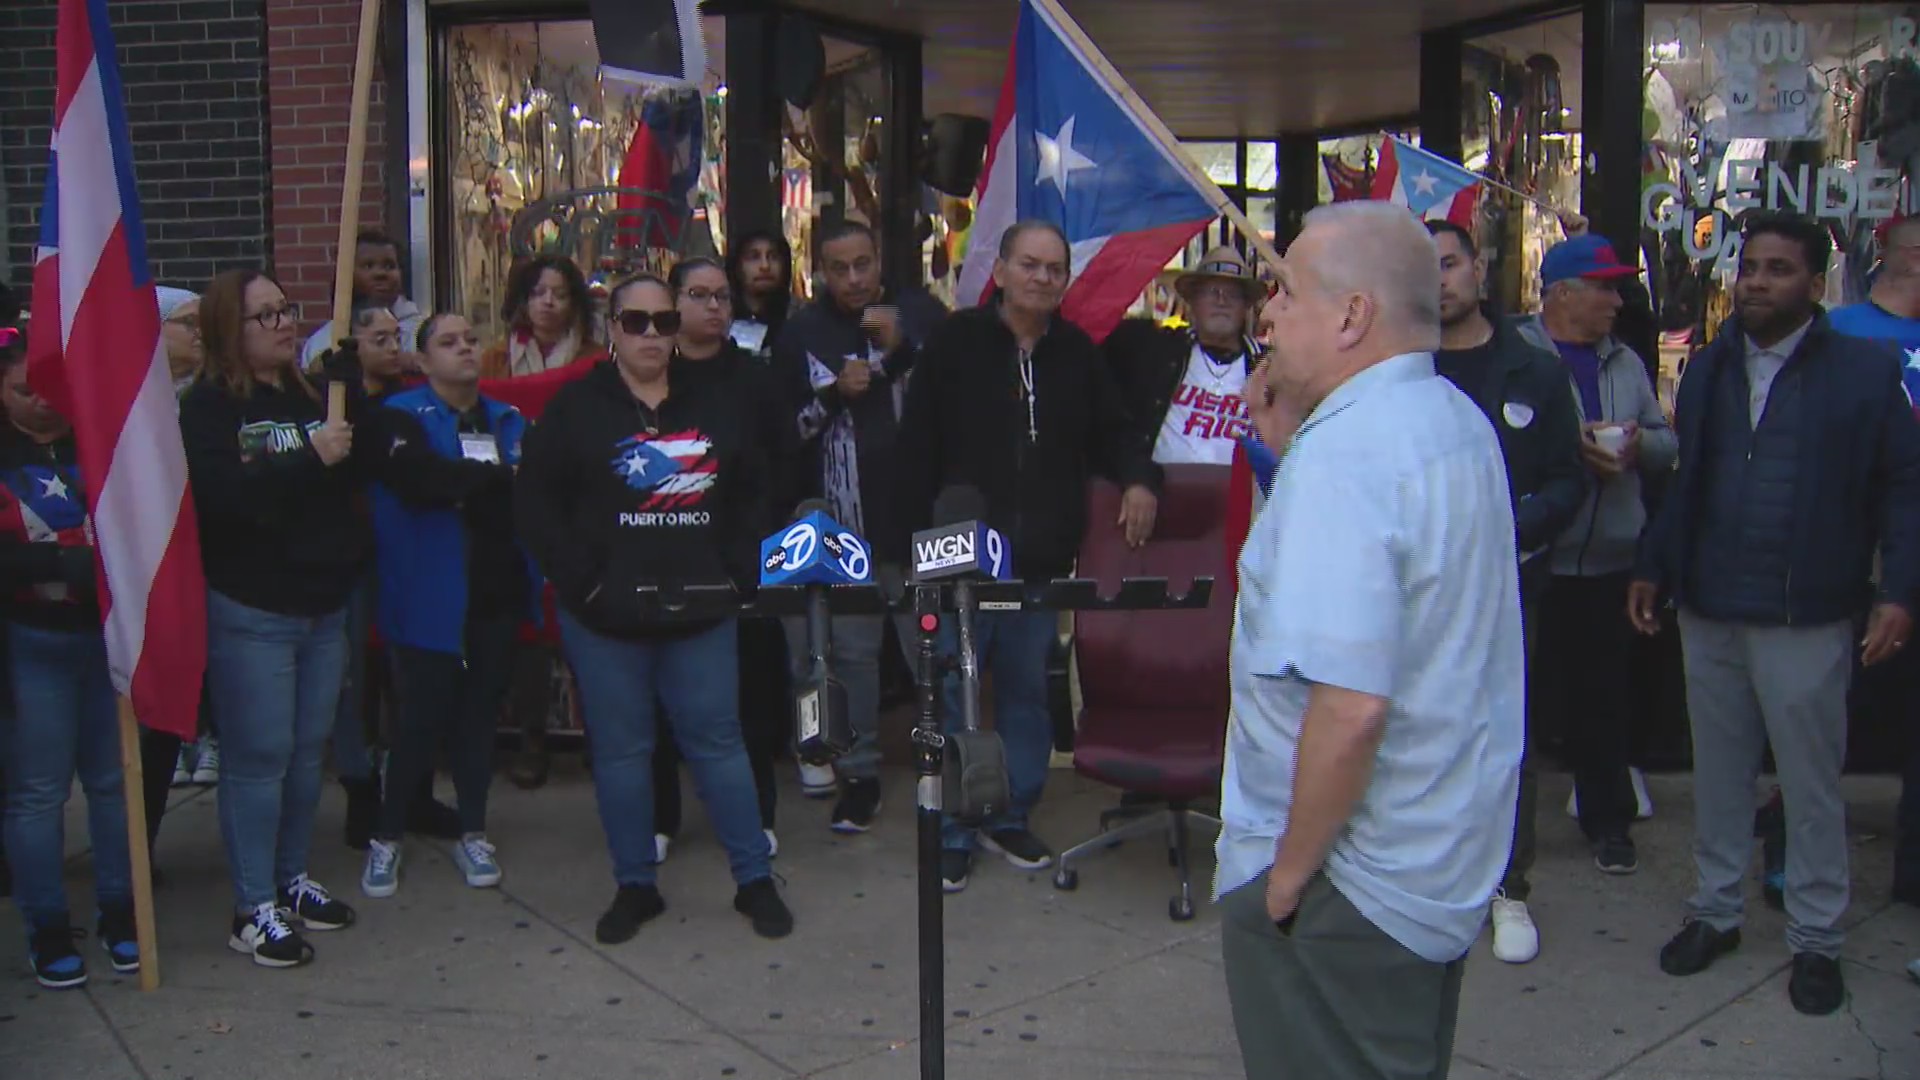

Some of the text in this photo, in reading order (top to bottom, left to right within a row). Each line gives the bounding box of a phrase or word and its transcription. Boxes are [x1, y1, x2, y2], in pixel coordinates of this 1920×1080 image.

[619, 511, 711, 526] PUERTO RICO
[765, 523, 817, 571] abc 7
[823, 535, 842, 555] abc
[916, 531, 975, 563] WGN
[986, 528, 1003, 578] 9
[934, 557, 956, 567] NEWS
